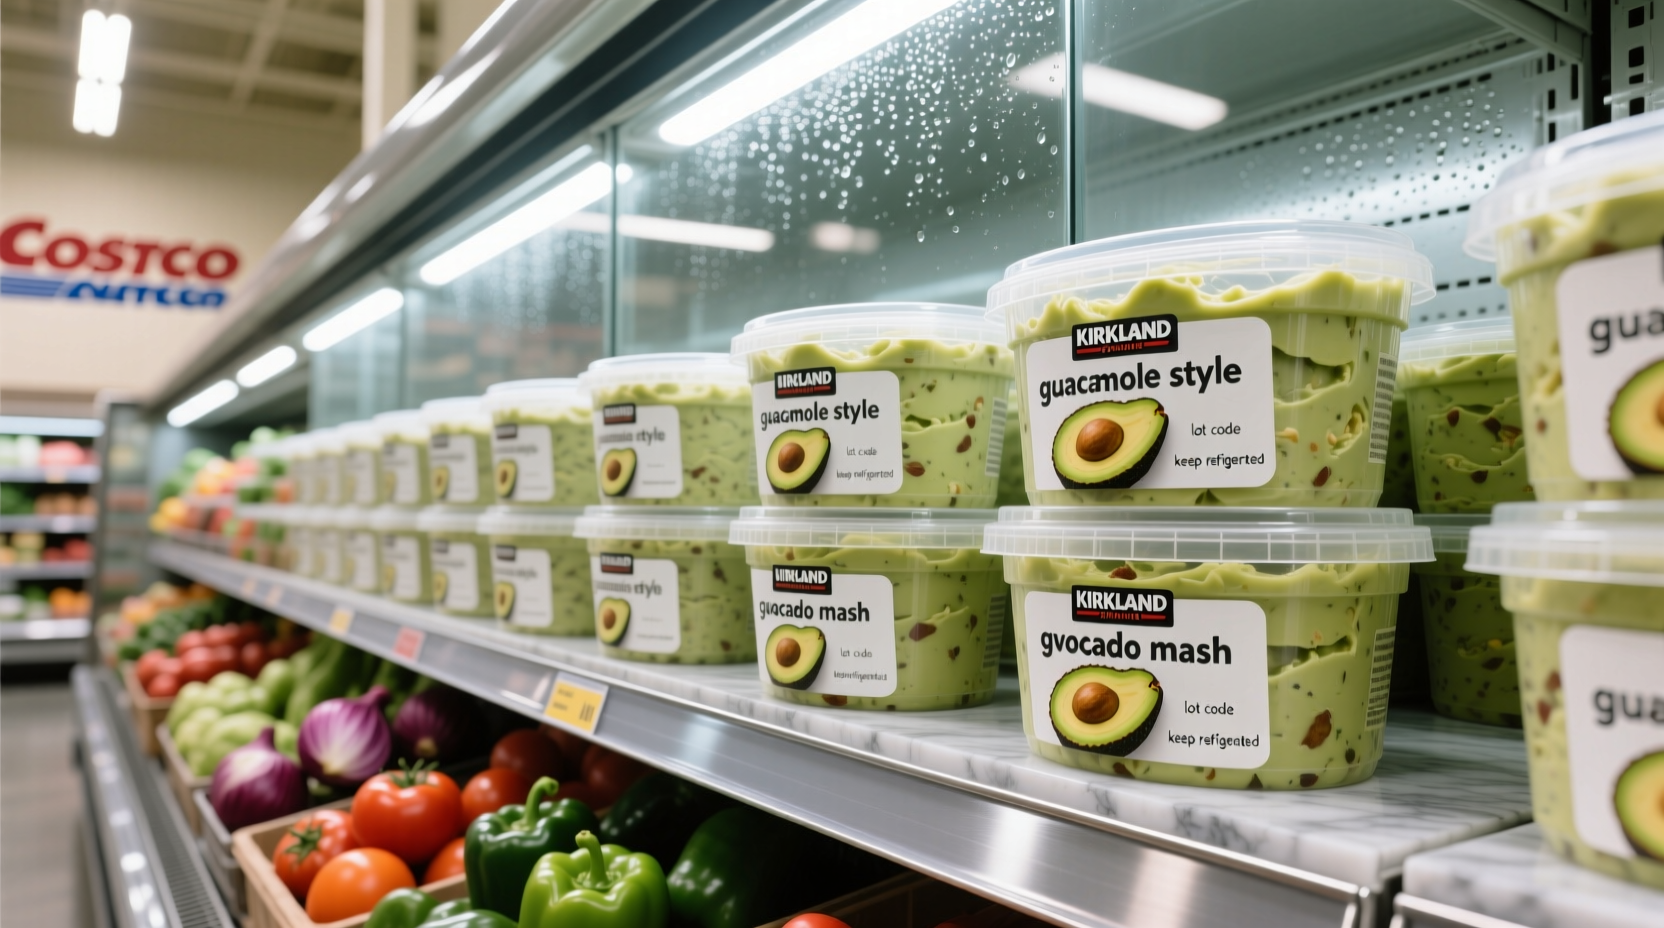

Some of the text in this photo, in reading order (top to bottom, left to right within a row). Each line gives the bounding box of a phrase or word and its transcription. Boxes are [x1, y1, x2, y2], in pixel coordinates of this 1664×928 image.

[1076, 319, 1172, 347] KIRKLAND
[1039, 354, 1242, 408] guacamole style
[833, 398, 880, 425] style
[1191, 422, 1241, 436] lot code
[1174, 453, 1202, 470] keep
[819, 601, 870, 622] mash
[1076, 590, 1168, 612] KIRKLAND
[1150, 636, 1232, 665] mash
[1184, 700, 1234, 715] lot code
[1168, 729, 1196, 748] keep
